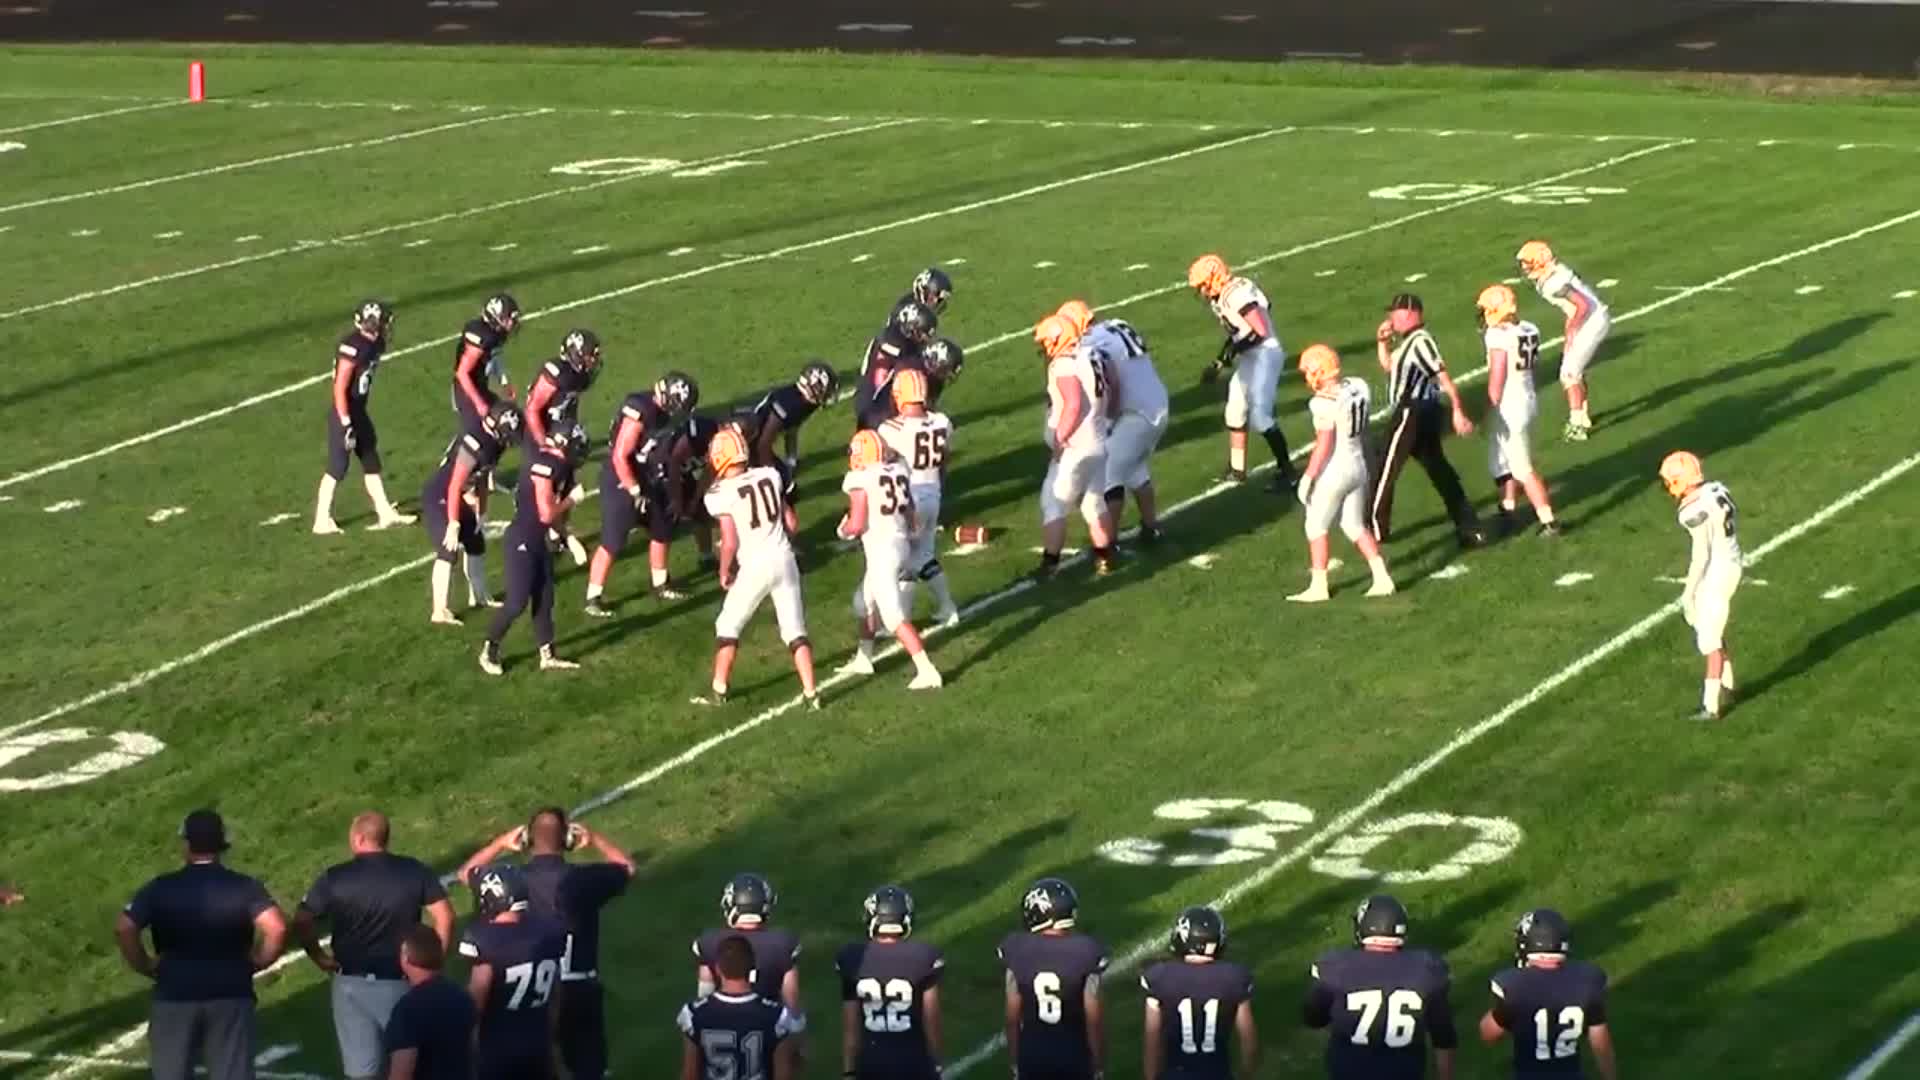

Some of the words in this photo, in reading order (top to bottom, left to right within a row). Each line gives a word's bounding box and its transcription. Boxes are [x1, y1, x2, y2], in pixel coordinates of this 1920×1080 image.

[914, 430, 947, 470] 65
[737, 478, 778, 529] 70
[879, 474, 914, 516] 33
[1098, 798, 1522, 883] 30
[505, 960, 556, 1010] 79
[856, 977, 913, 1032] 22
[1033, 971, 1062, 1024] 6
[1178, 998, 1219, 1053] 11
[1347, 990, 1422, 1048] 76
[1534, 1006, 1584, 1060] 12
[701, 1029, 765, 1080] 51
